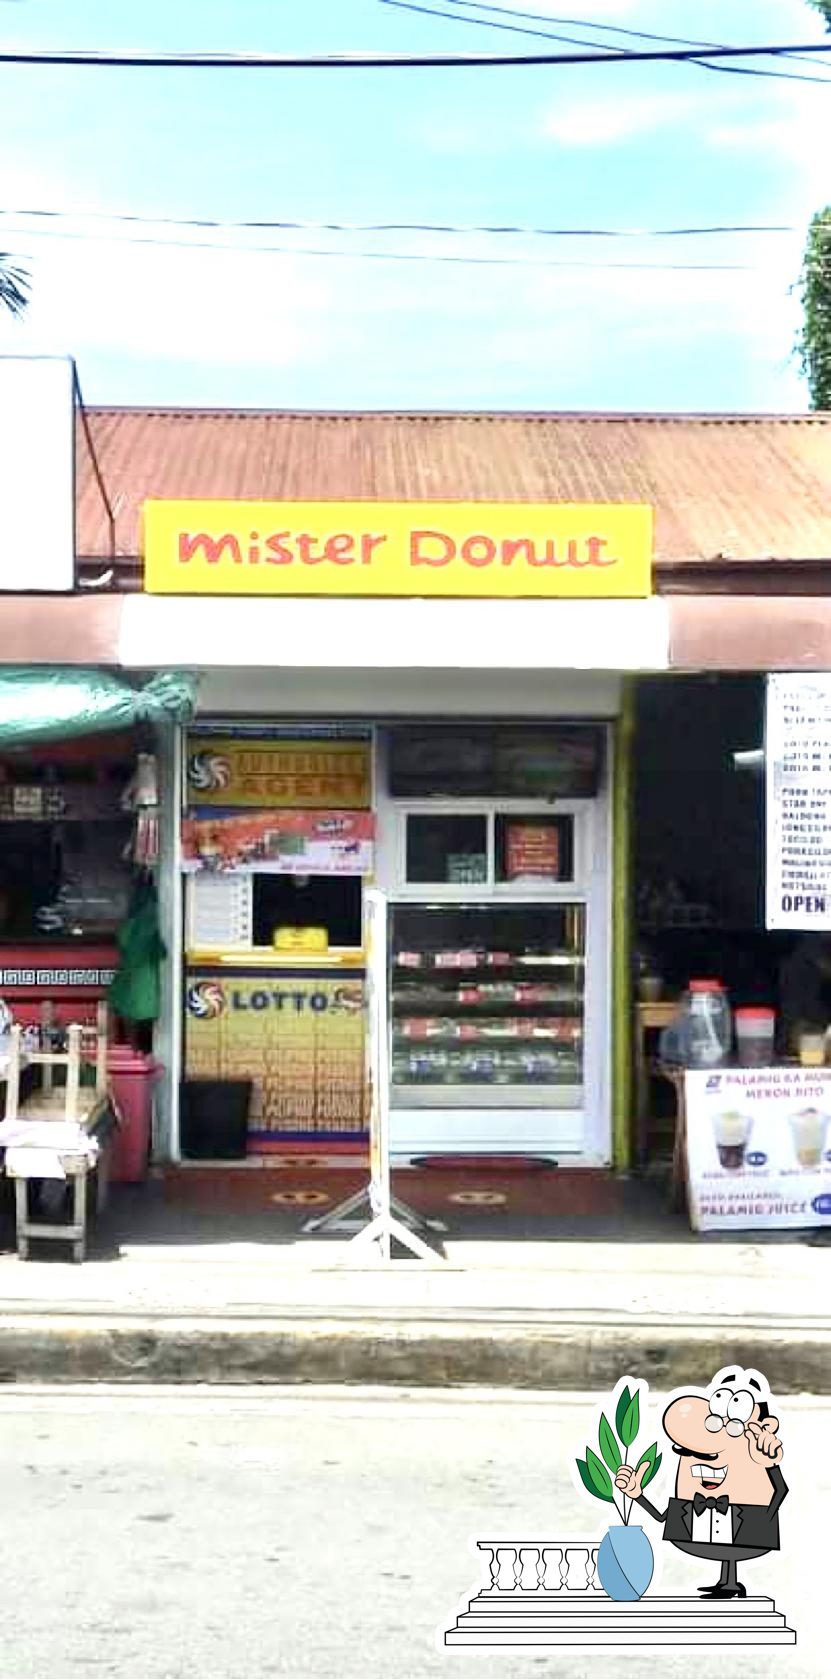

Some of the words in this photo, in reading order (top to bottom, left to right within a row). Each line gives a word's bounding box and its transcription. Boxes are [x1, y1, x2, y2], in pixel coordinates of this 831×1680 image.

[409, 529, 619, 568] Donut
[781, 894, 826, 913] OPEN
[231, 989, 329, 1013] LOTTO
